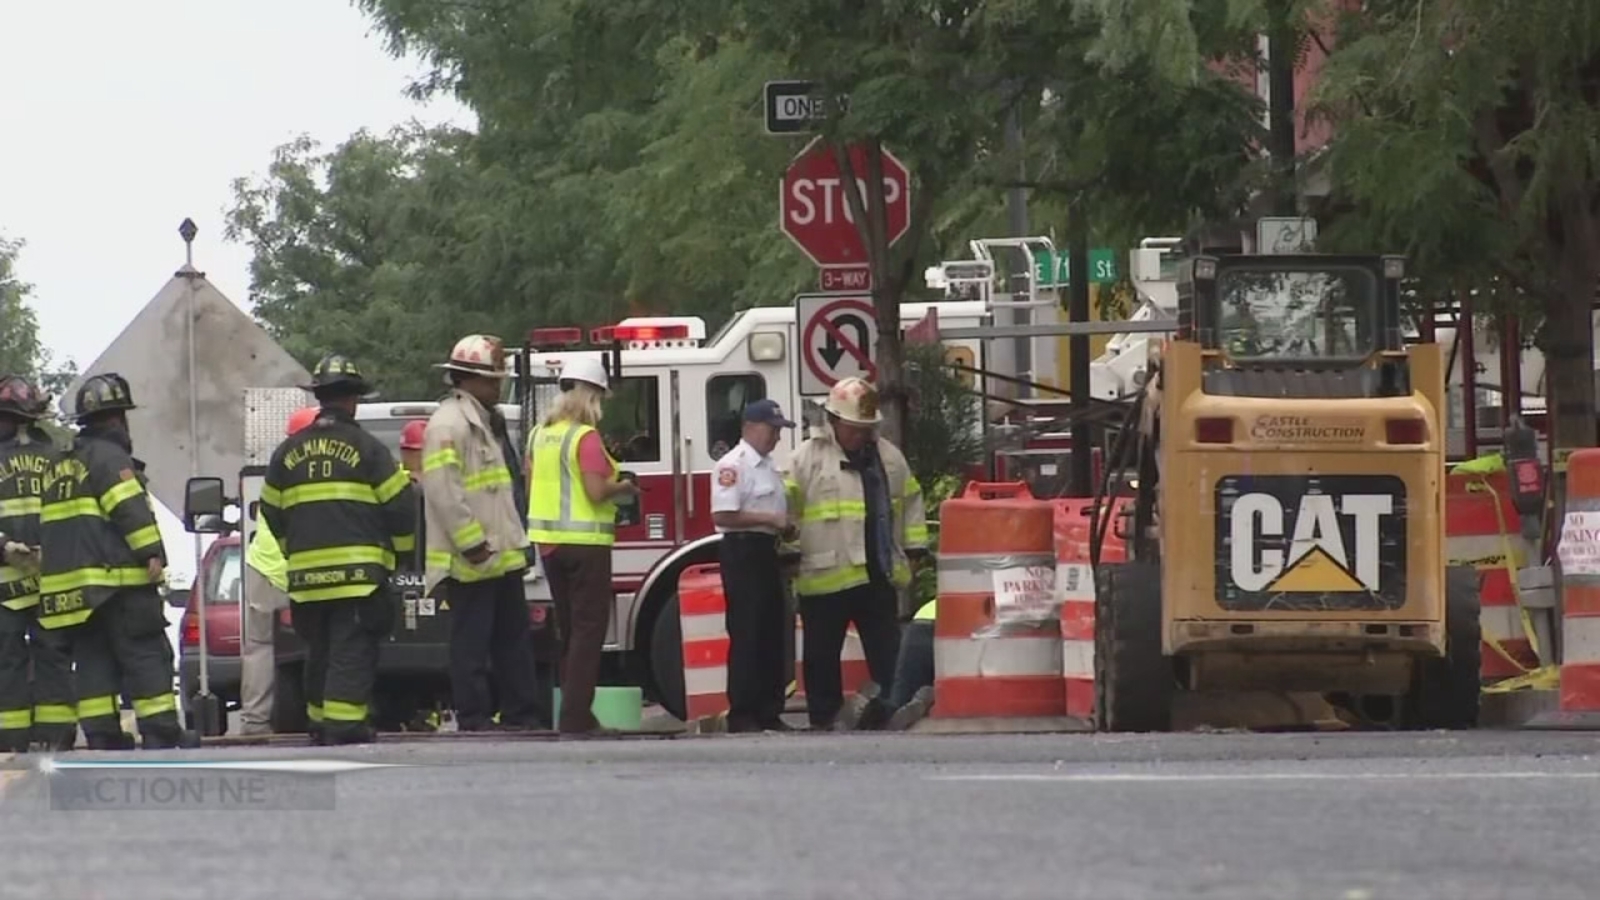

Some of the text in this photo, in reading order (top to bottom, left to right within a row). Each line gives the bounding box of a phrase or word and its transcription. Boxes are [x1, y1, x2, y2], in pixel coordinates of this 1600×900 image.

[784, 97, 824, 117] ONE
[1096, 260, 1111, 278] St
[824, 271, 867, 288] 3-WAY
[1256, 414, 1308, 428] CASTLE
[1251, 427, 1365, 439] CONSTRUCTION
[284, 438, 360, 470] WILMINGTON
[1231, 493, 1392, 592] CAT
